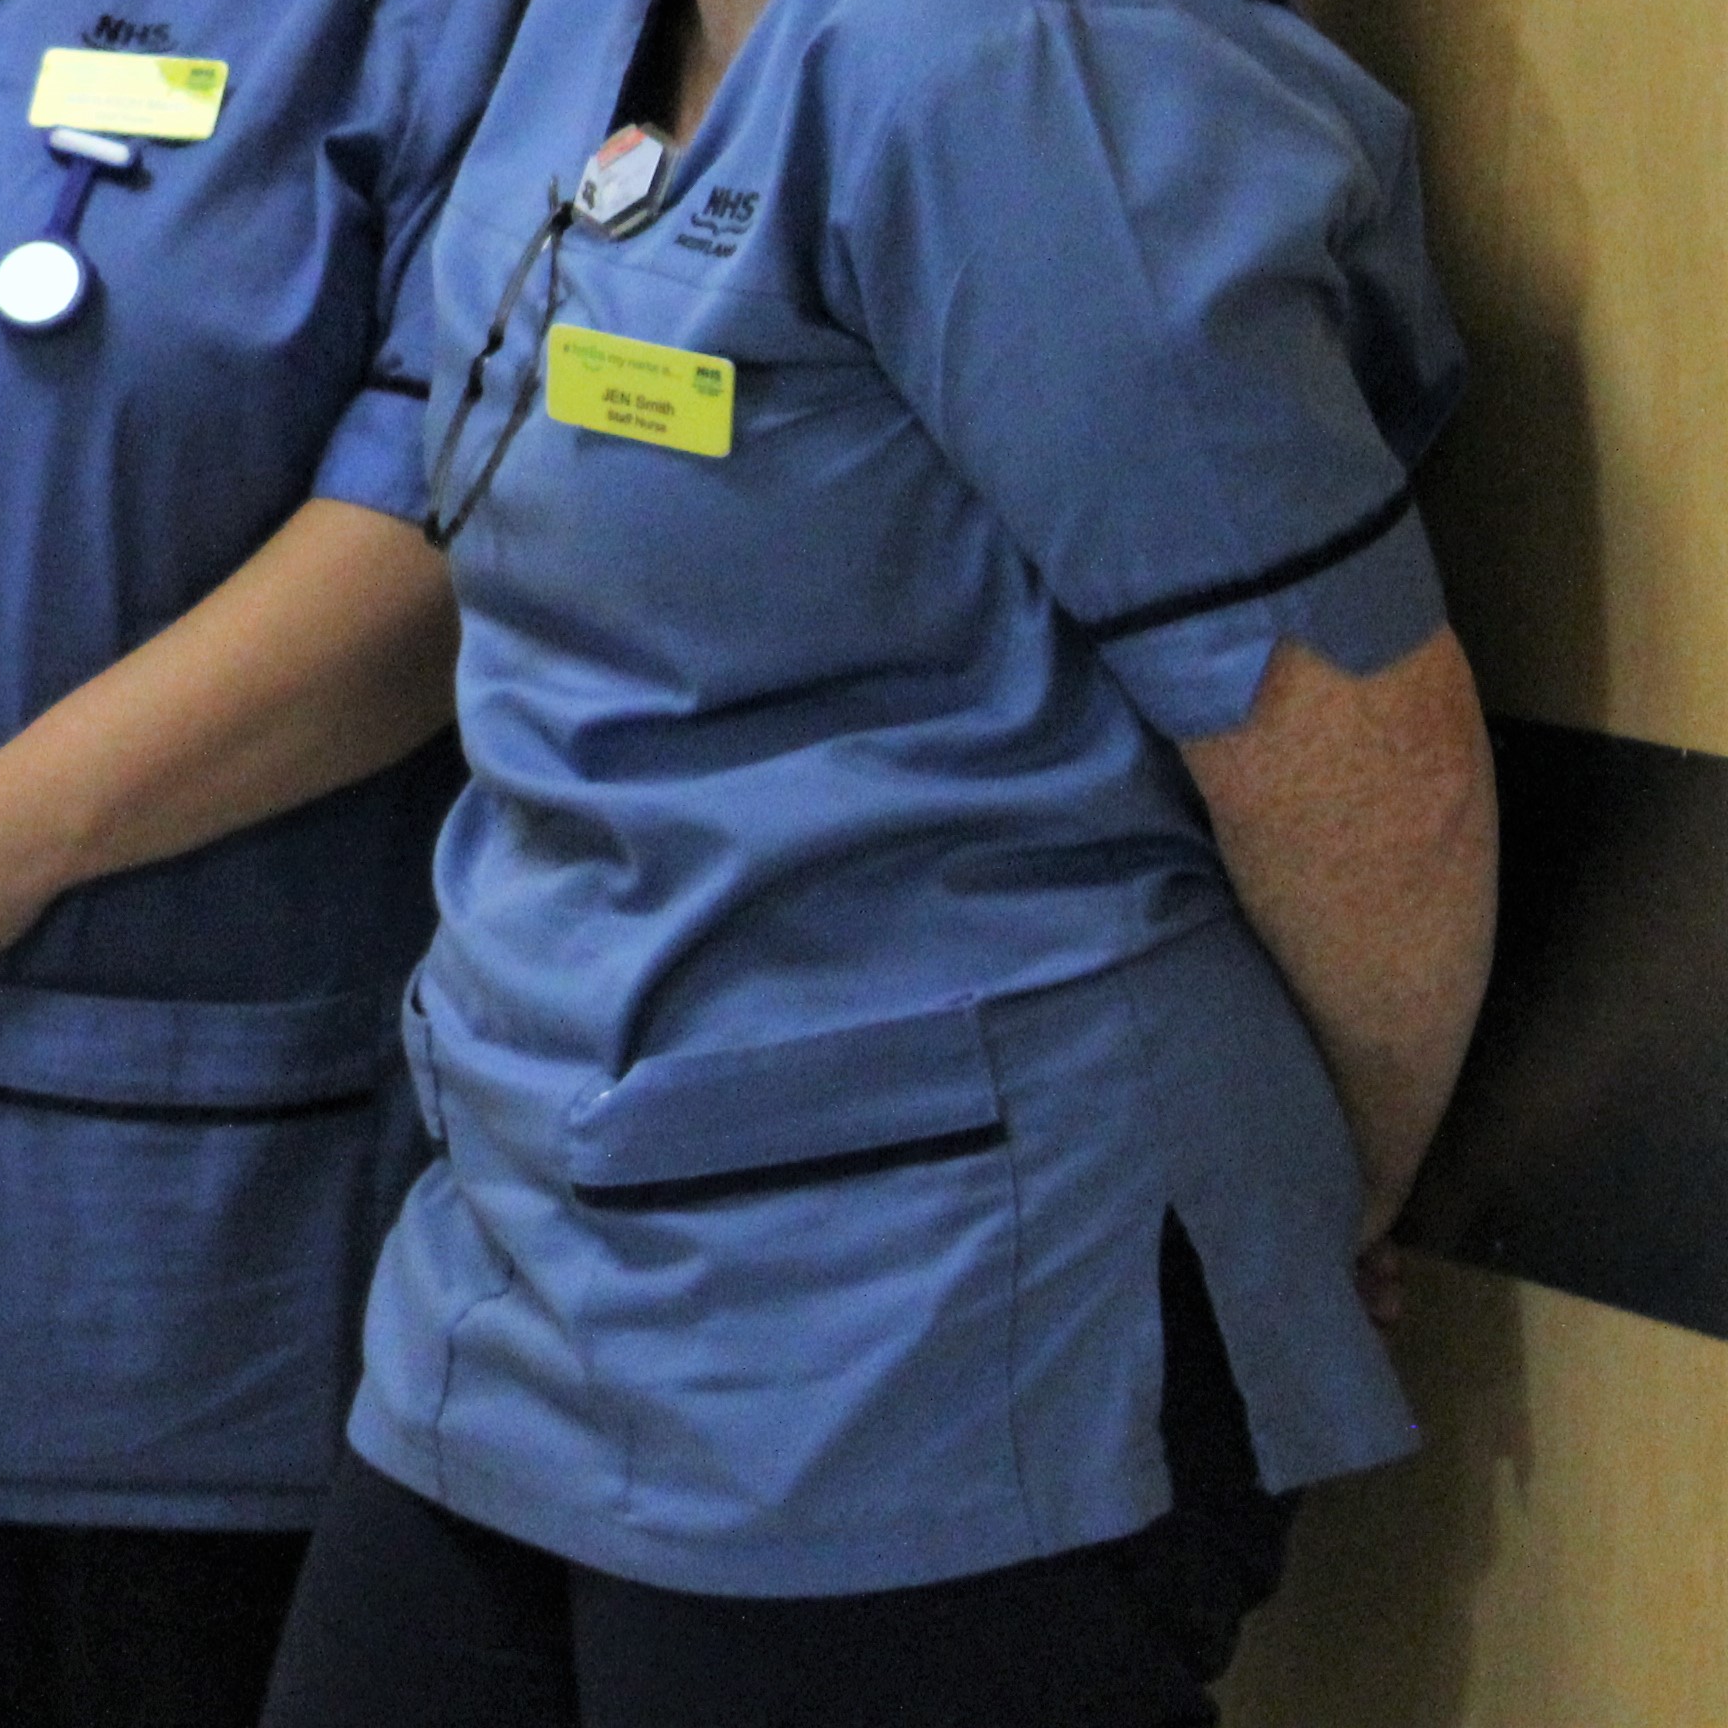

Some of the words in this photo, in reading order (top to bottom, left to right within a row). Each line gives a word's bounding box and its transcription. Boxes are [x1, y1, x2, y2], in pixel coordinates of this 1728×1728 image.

[702, 185, 760, 222] NHS
[696, 366, 722, 381] NHS
[602, 386, 631, 407] JEN
[635, 393, 676, 416] Smith
